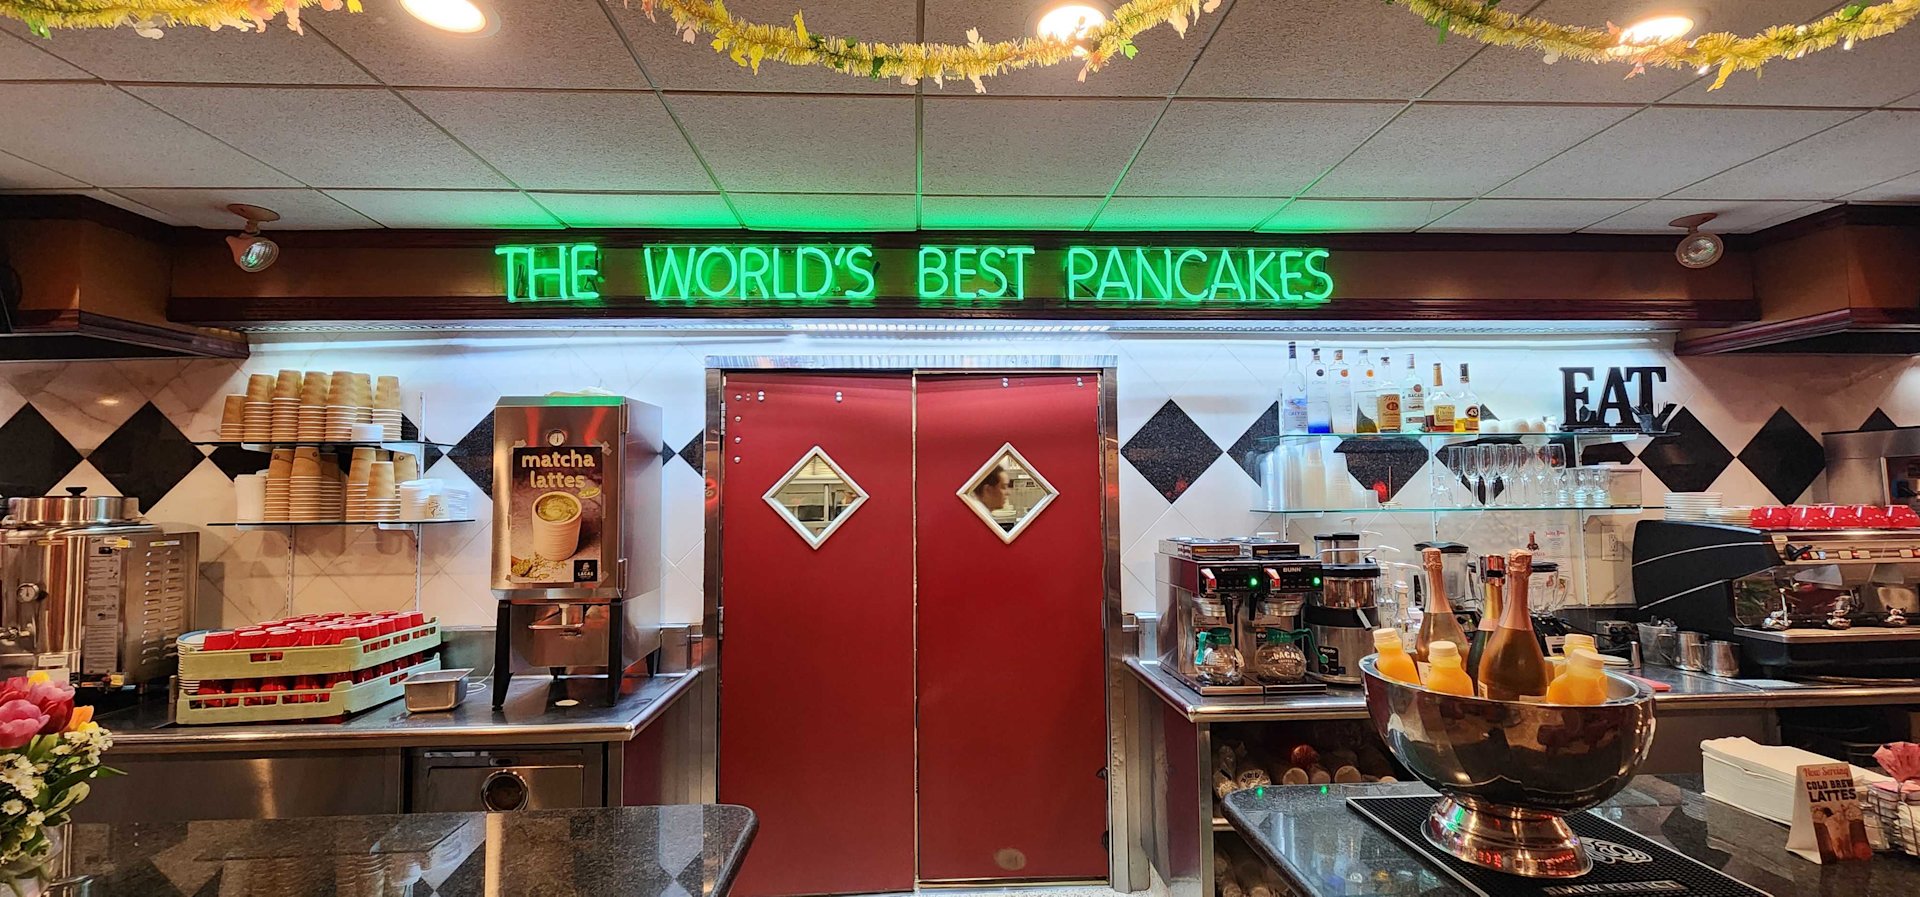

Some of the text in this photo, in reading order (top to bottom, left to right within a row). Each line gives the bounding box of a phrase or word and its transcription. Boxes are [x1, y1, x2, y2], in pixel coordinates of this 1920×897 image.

[495, 245, 1334, 302] THE WORLD'S BEST PANCAKES
[1559, 366, 1667, 428] EAT
[521, 449, 596, 468] matcha
[530, 470, 587, 489] lattes
[1803, 766, 1849, 778] Now Serving
[1806, 778, 1854, 790] COLD BREW
[1808, 788, 1857, 803] LATTES
[1543, 884, 1603, 895] SIMPLY
